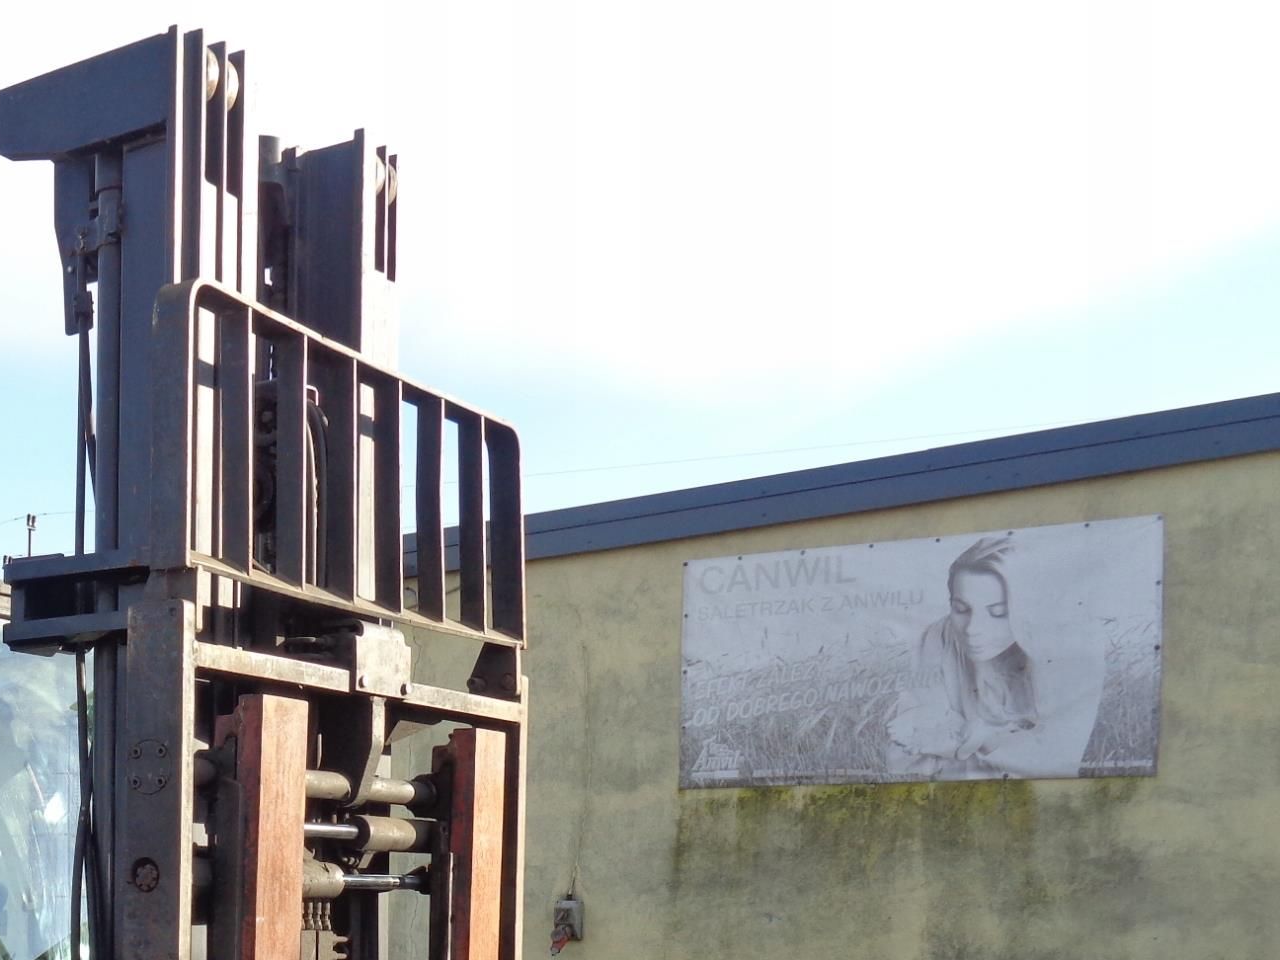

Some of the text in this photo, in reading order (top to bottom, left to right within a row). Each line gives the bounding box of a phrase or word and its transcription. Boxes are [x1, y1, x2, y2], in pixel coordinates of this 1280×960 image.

[699, 555, 857, 594] CANWIL
[821, 597, 833, 612] Z
[692, 707, 721, 727] OD
[727, 688, 818, 721] DOBREGO
